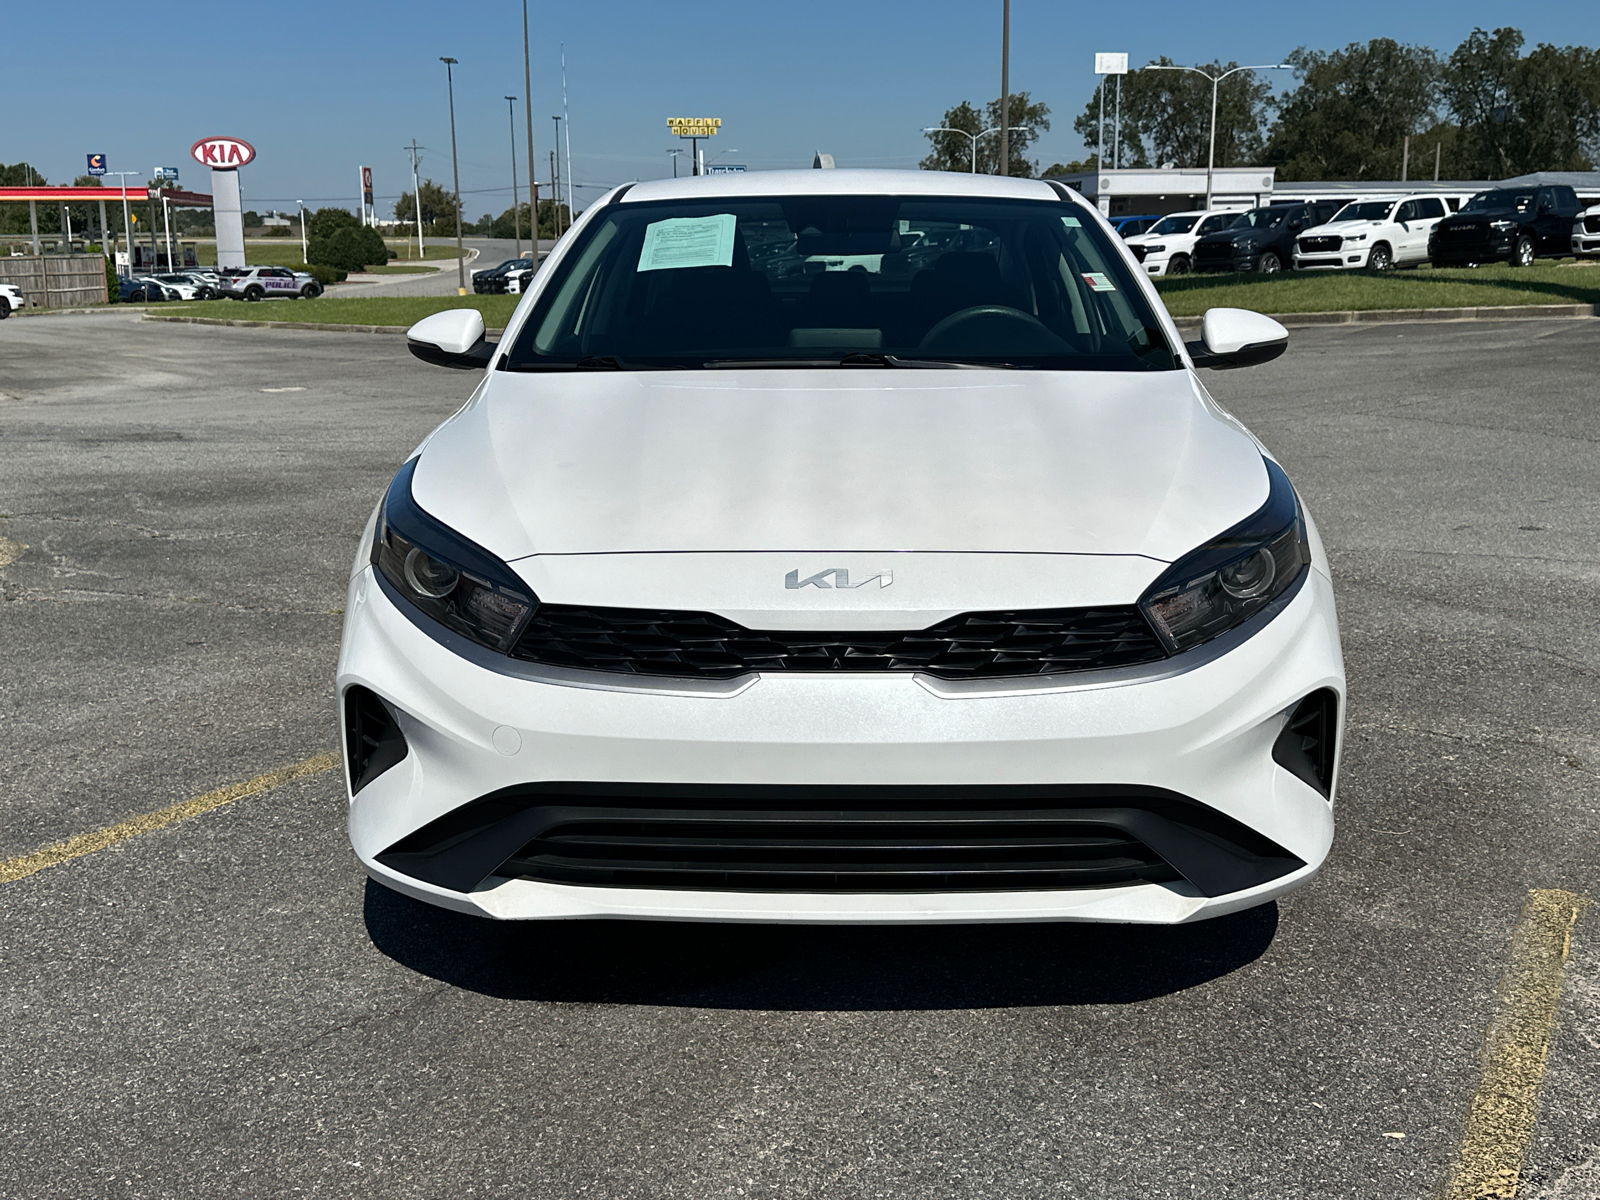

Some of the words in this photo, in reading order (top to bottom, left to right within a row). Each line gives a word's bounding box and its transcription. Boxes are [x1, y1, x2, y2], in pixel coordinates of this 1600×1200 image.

[201, 144, 244, 164] KIA
[265, 281, 298, 289] POLICE
[784, 568, 893, 589] KIA
